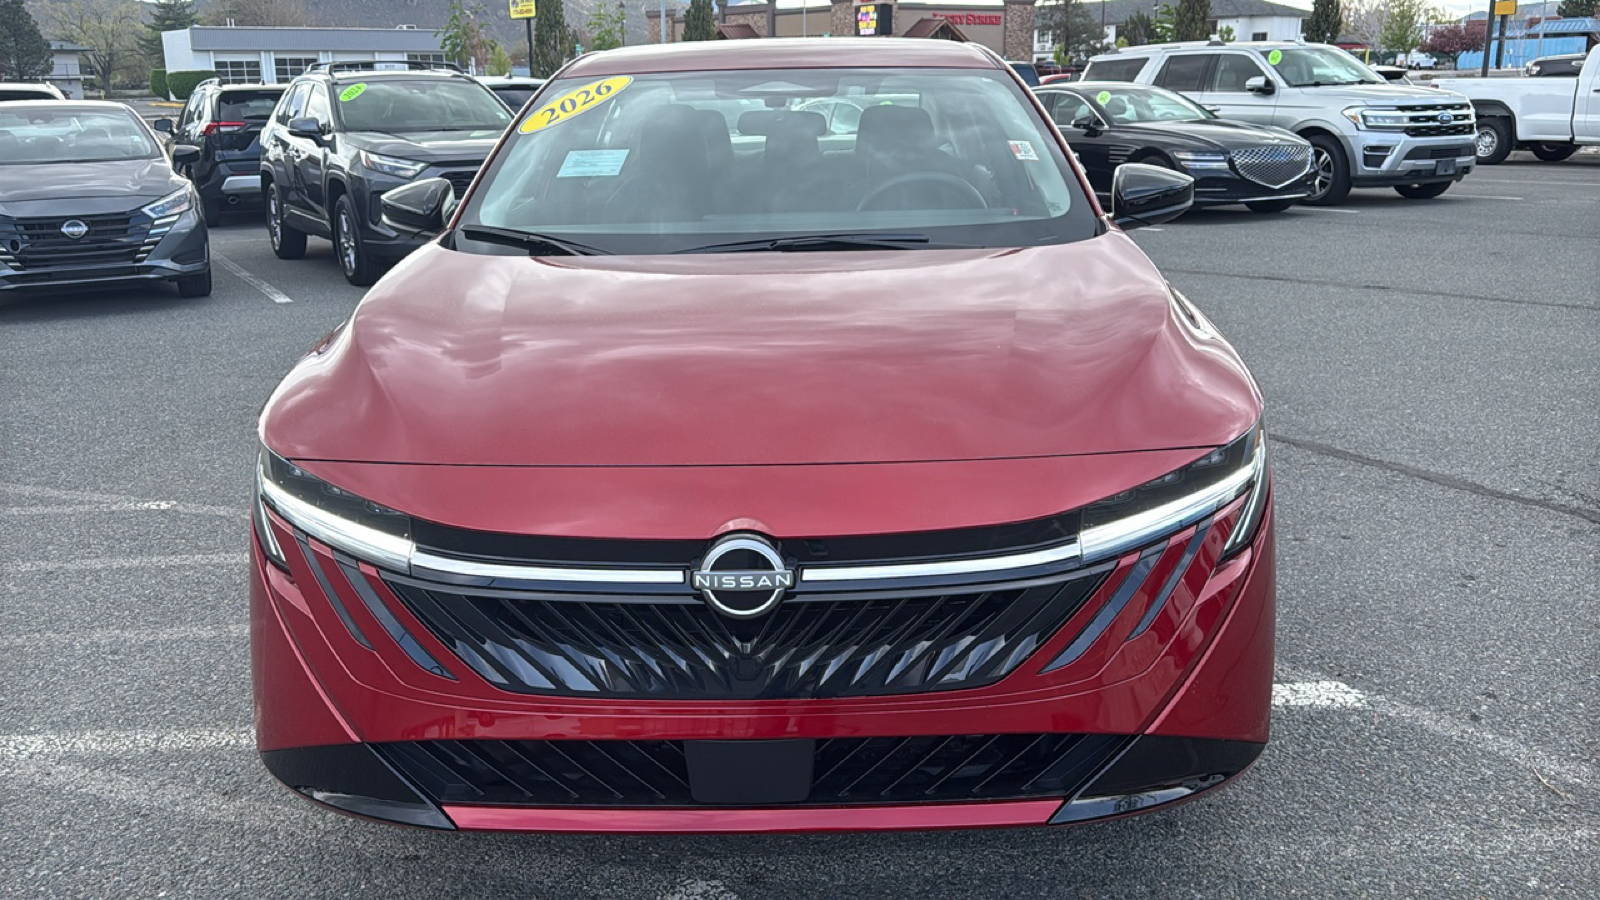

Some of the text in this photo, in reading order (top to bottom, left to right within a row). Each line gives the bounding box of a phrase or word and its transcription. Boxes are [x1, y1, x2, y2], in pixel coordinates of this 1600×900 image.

[933, 12, 1002, 25] CKY STRIKE
[540, 80, 612, 125] 2026
[695, 574, 791, 588] NISSAN
